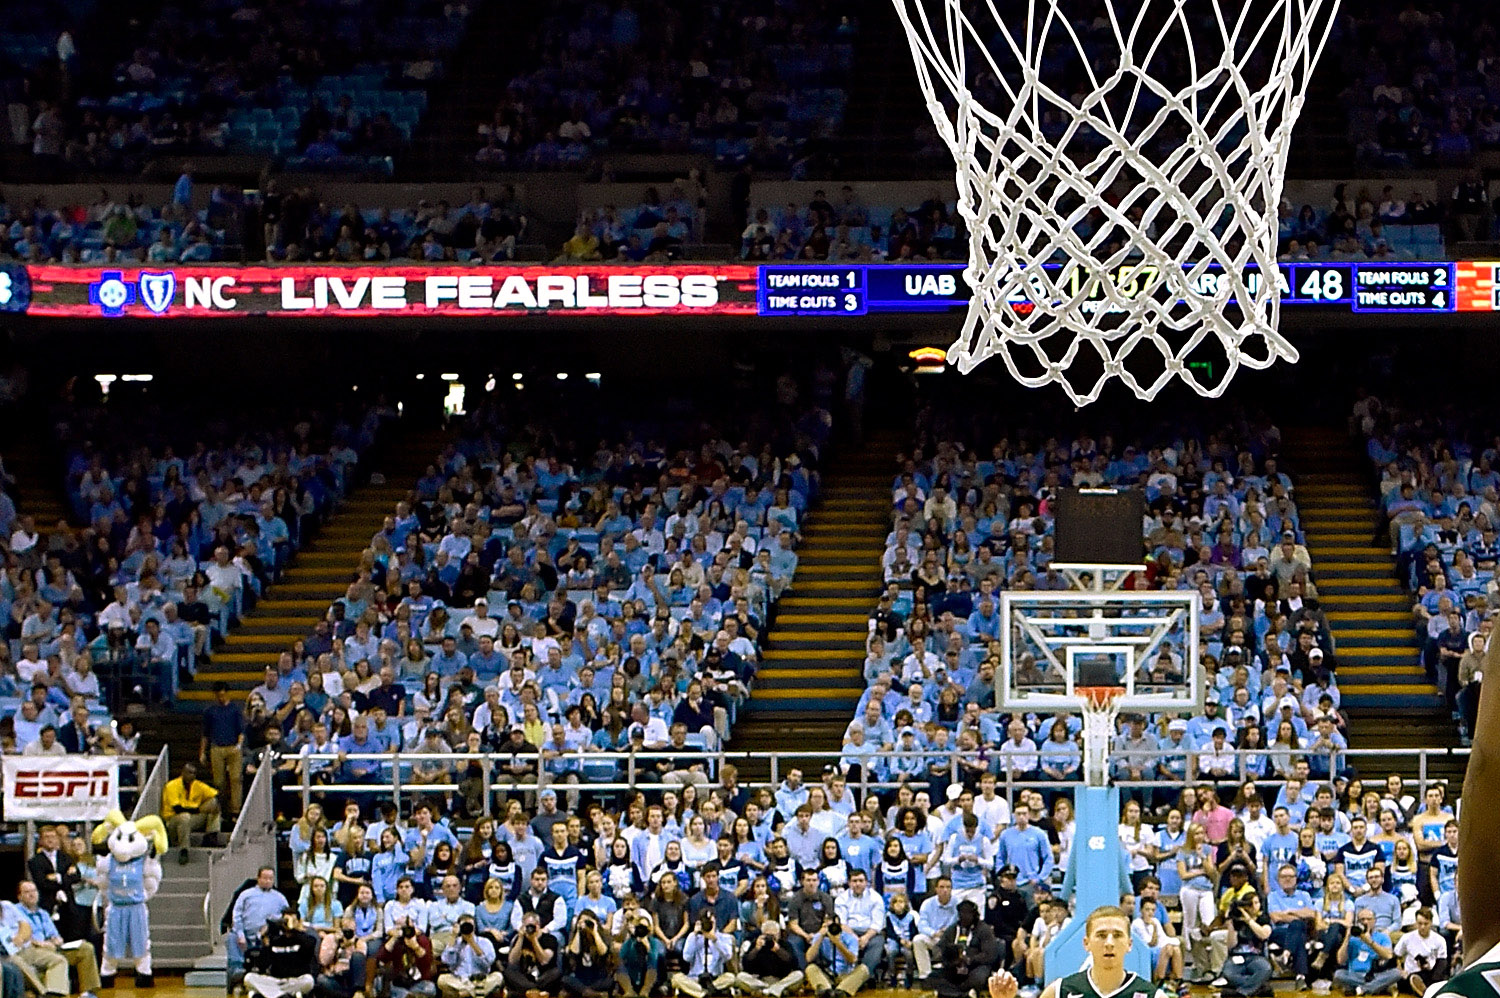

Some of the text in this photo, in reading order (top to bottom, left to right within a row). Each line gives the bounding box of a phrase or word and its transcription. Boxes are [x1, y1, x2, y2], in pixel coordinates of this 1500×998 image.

[768, 271, 856, 288] TEAM FOULS 1
[905, 274, 956, 296] UAB
[1301, 270, 1343, 300] 48
[1358, 268, 1447, 286] TEAM FOULS 2
[185, 275, 719, 309] NC LIVE FEARLESS
[1358, 291, 1446, 307] TIME OUTS 4
[768, 294, 857, 311] TIME OUTS 3
[14, 771, 109, 797] ESPN
